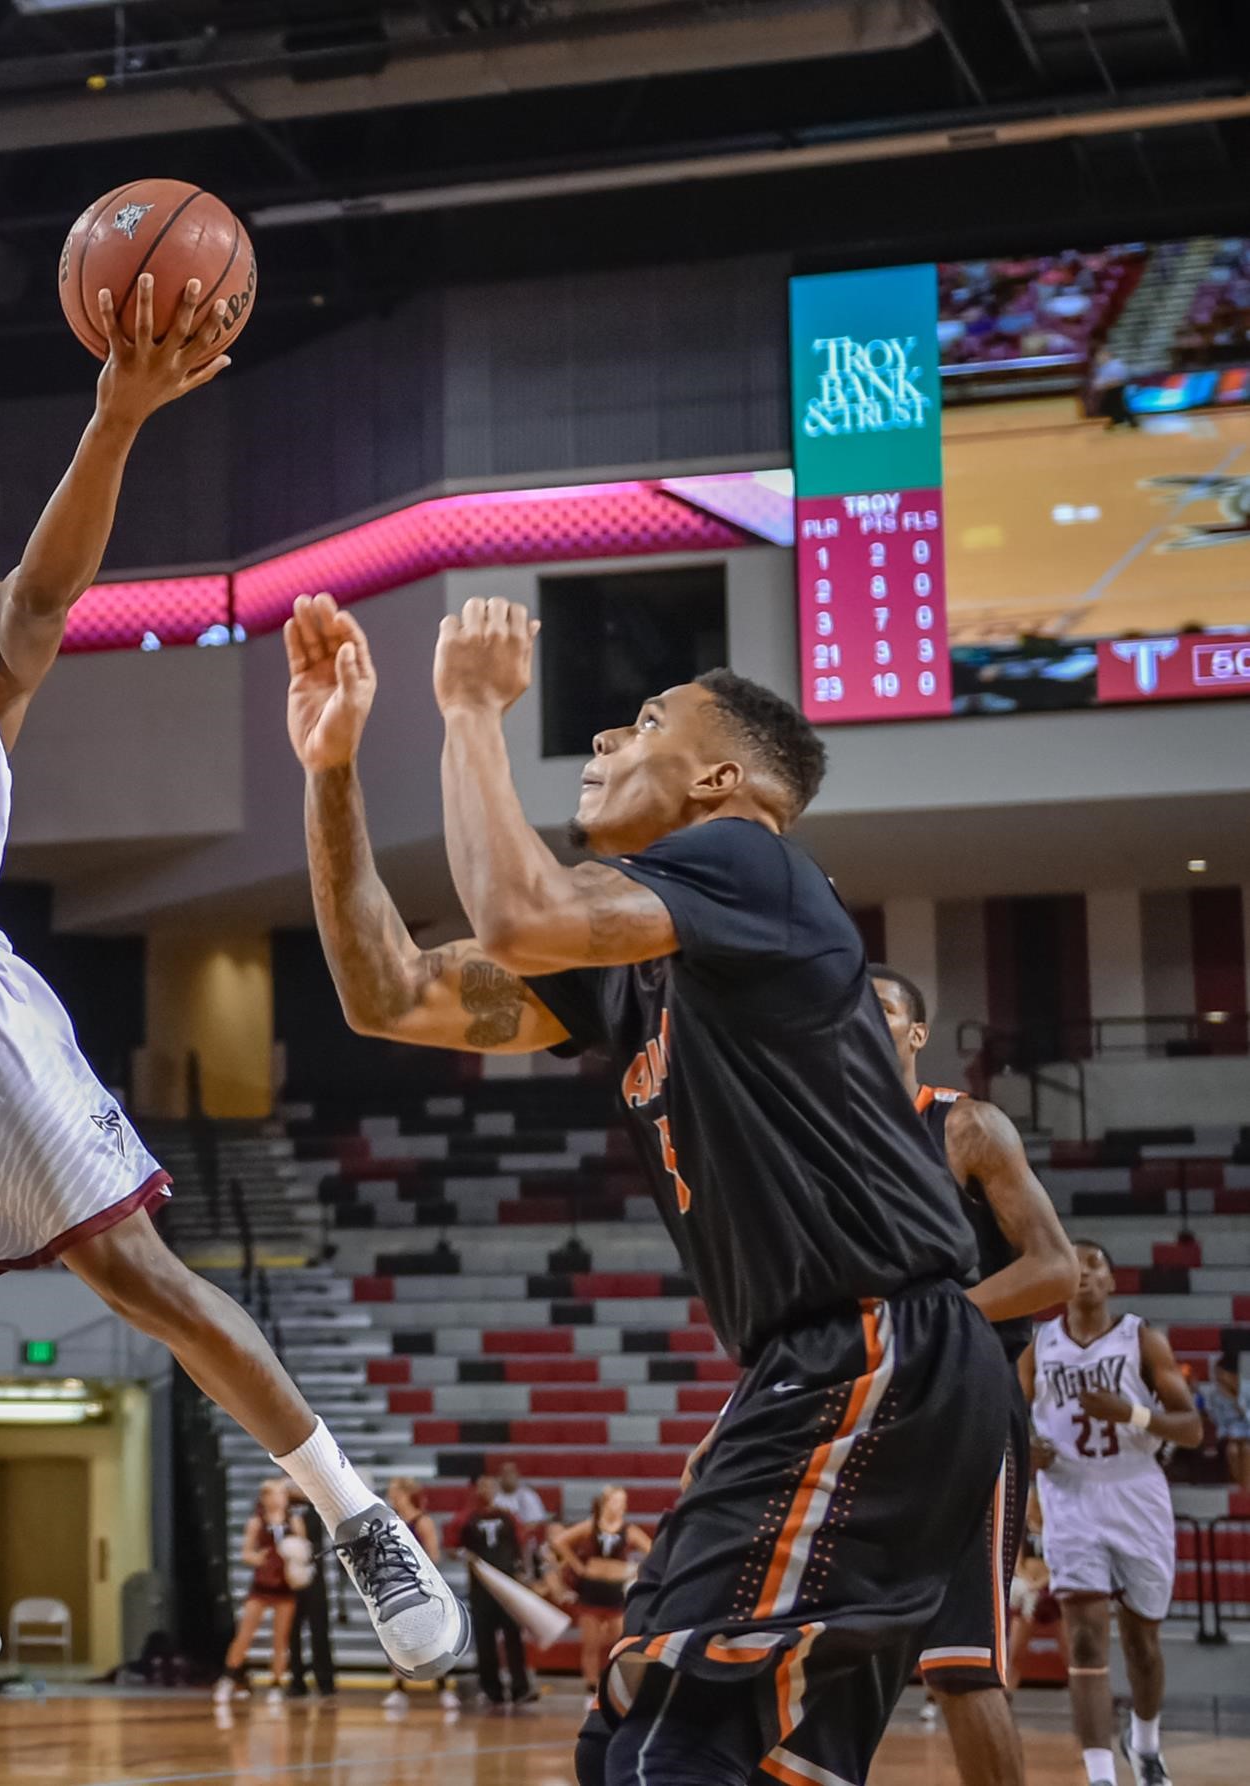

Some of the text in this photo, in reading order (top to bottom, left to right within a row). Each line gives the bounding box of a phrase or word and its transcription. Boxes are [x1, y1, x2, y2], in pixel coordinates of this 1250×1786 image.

[812, 335, 918, 378] TROY
[817, 366, 923, 409] BANK
[843, 492, 901, 518] TROY
[860, 511, 898, 535] PTS
[902, 510, 938, 532] FLS
[815, 546, 830, 571] 1
[912, 539, 931, 565] 0
[914, 572, 932, 597] 0
[816, 605, 934, 636] 3 7 0
[813, 638, 935, 669] 21 3 3
[814, 670, 937, 702] 23 10 0
[1071, 1414, 1119, 1457] 23
